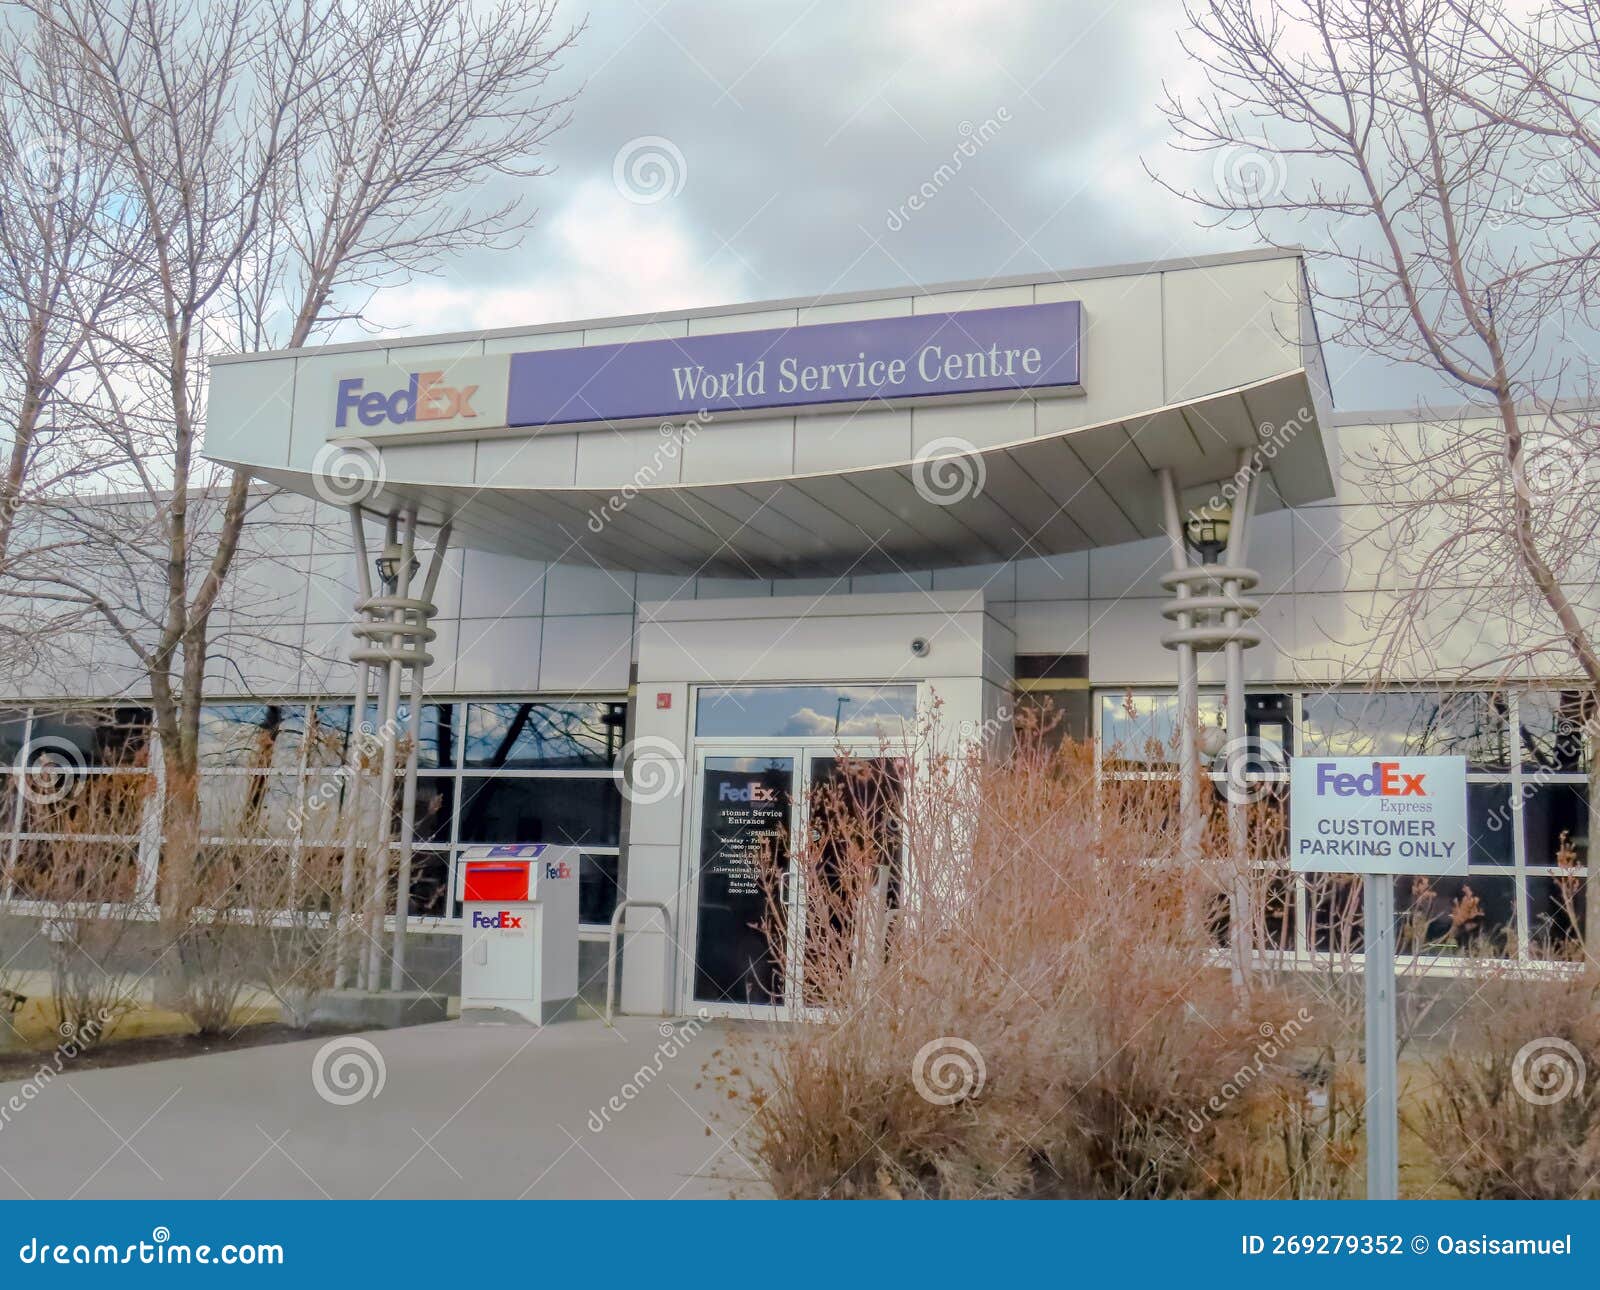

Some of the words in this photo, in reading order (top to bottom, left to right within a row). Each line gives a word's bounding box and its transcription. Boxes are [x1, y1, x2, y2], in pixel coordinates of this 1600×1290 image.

[672, 360, 766, 400] World
[778, 351, 906, 393] Service
[918, 341, 1042, 383] Centre
[335, 370, 480, 428] FedEx
[1316, 761, 1427, 797] FedEx
[719, 781, 775, 801] FedEx
[720, 809, 749, 817] stomer
[752, 809, 783, 817] Service
[1380, 798, 1433, 815] Express
[728, 817, 765, 825] Entrance
[1317, 818, 1436, 837] CUSTOMER
[1300, 839, 1392, 857] PARKING
[1399, 840, 1456, 858] ONLY
[545, 861, 572, 880] FedEx
[472, 910, 522, 930] FedEx
